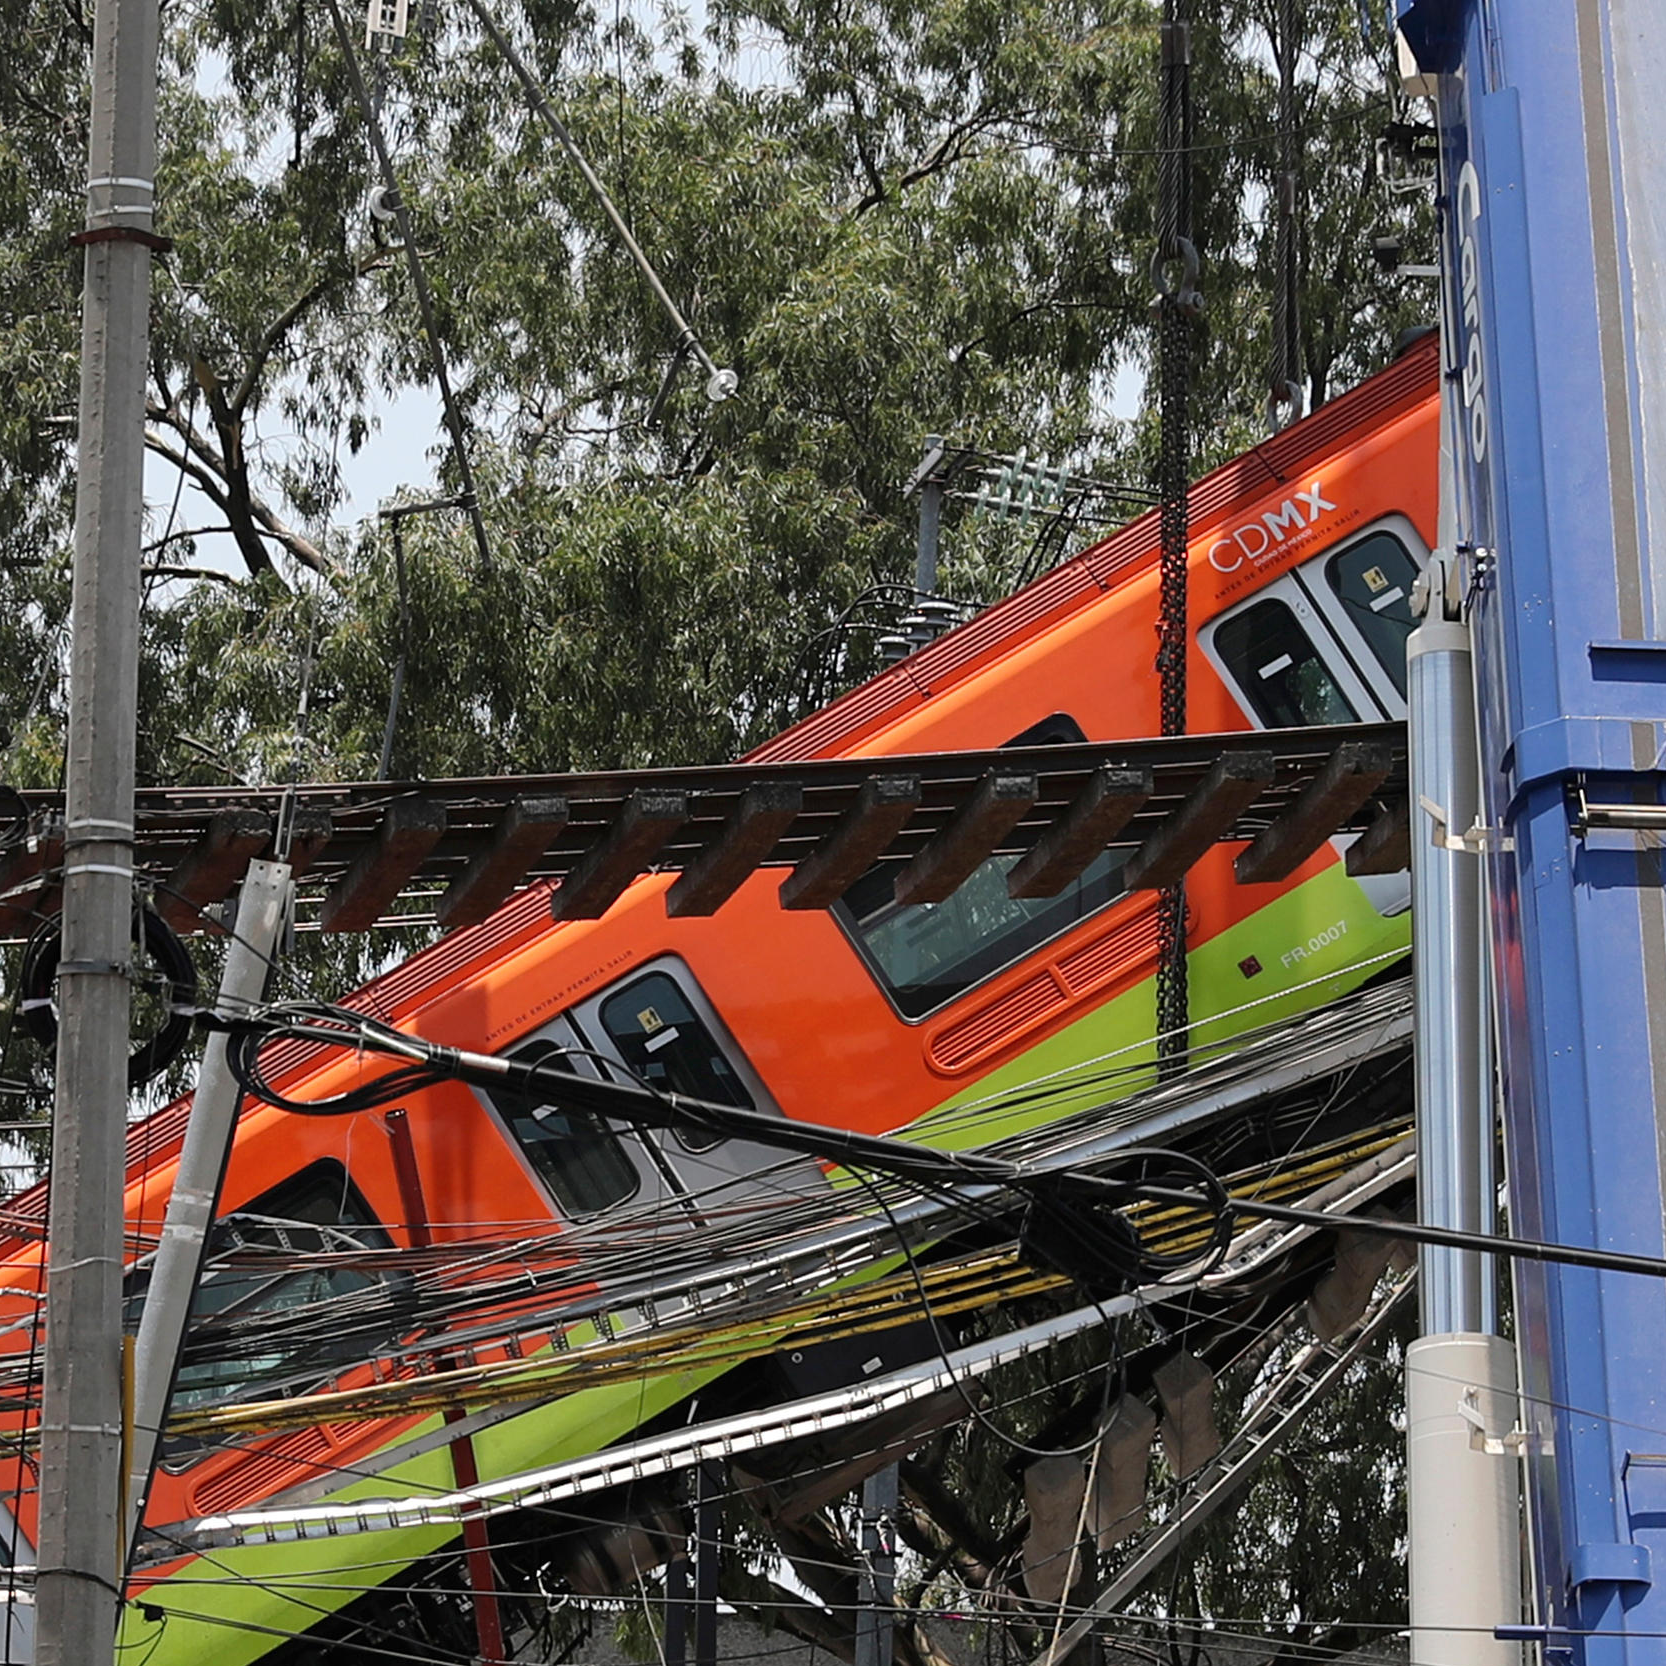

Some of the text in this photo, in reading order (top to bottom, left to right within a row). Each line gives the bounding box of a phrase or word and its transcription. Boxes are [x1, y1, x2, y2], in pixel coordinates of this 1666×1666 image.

[1457, 160, 1486, 464] Cargo
[1208, 481, 1337, 573] CDMX
[1280, 920, 1348, 968] FR.0007
[485, 1022, 514, 1043] ANTES
